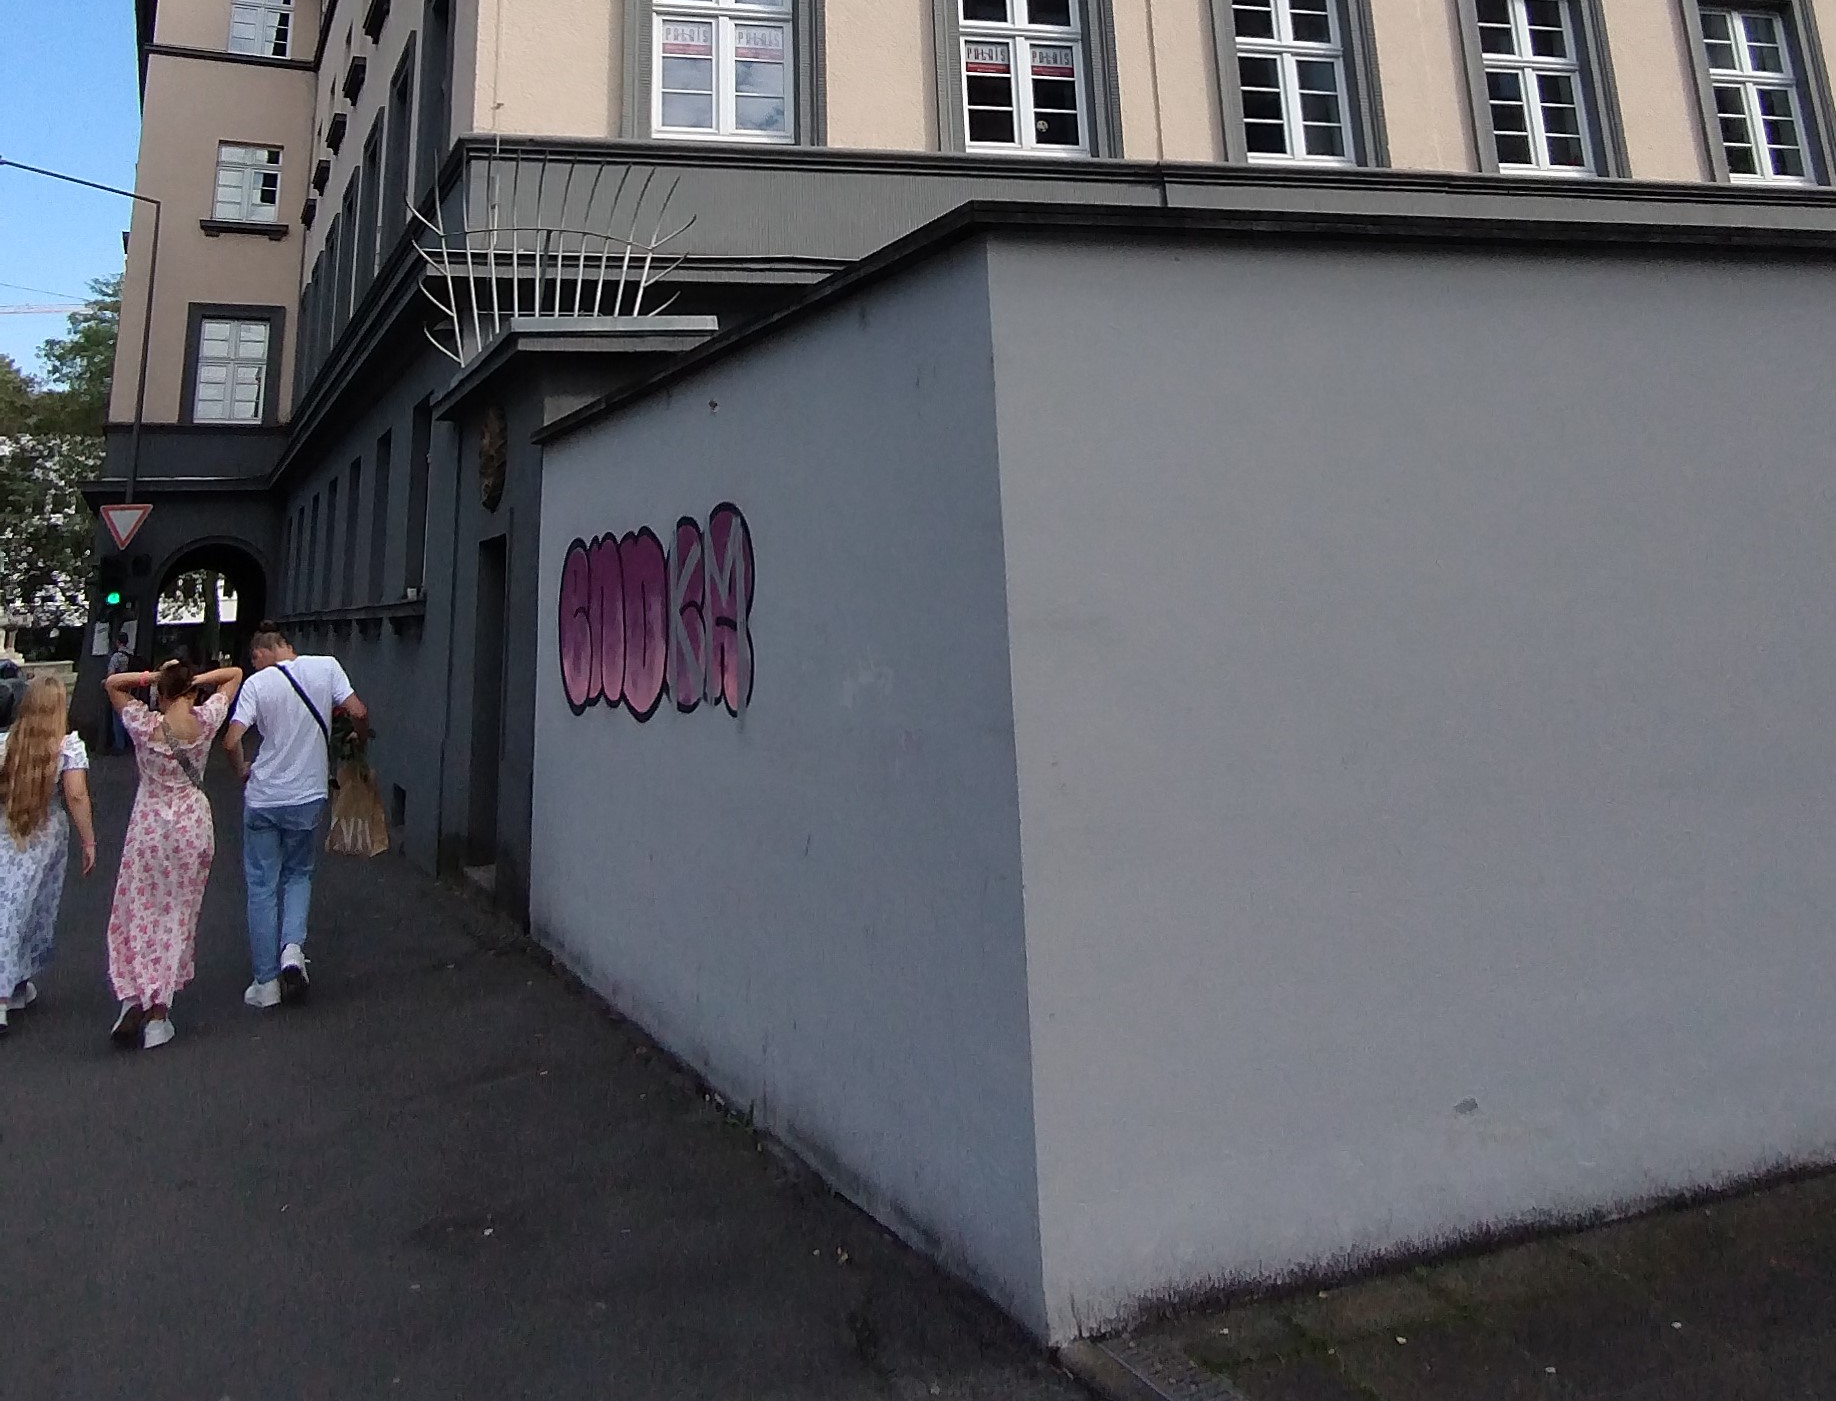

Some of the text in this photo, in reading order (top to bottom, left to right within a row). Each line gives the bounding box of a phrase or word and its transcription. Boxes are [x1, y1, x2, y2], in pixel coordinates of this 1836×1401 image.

[665, 26, 708, 42] PALAIS
[967, 46, 1005, 62] PALAIS
[1031, 50, 1069, 65] PALAIS
